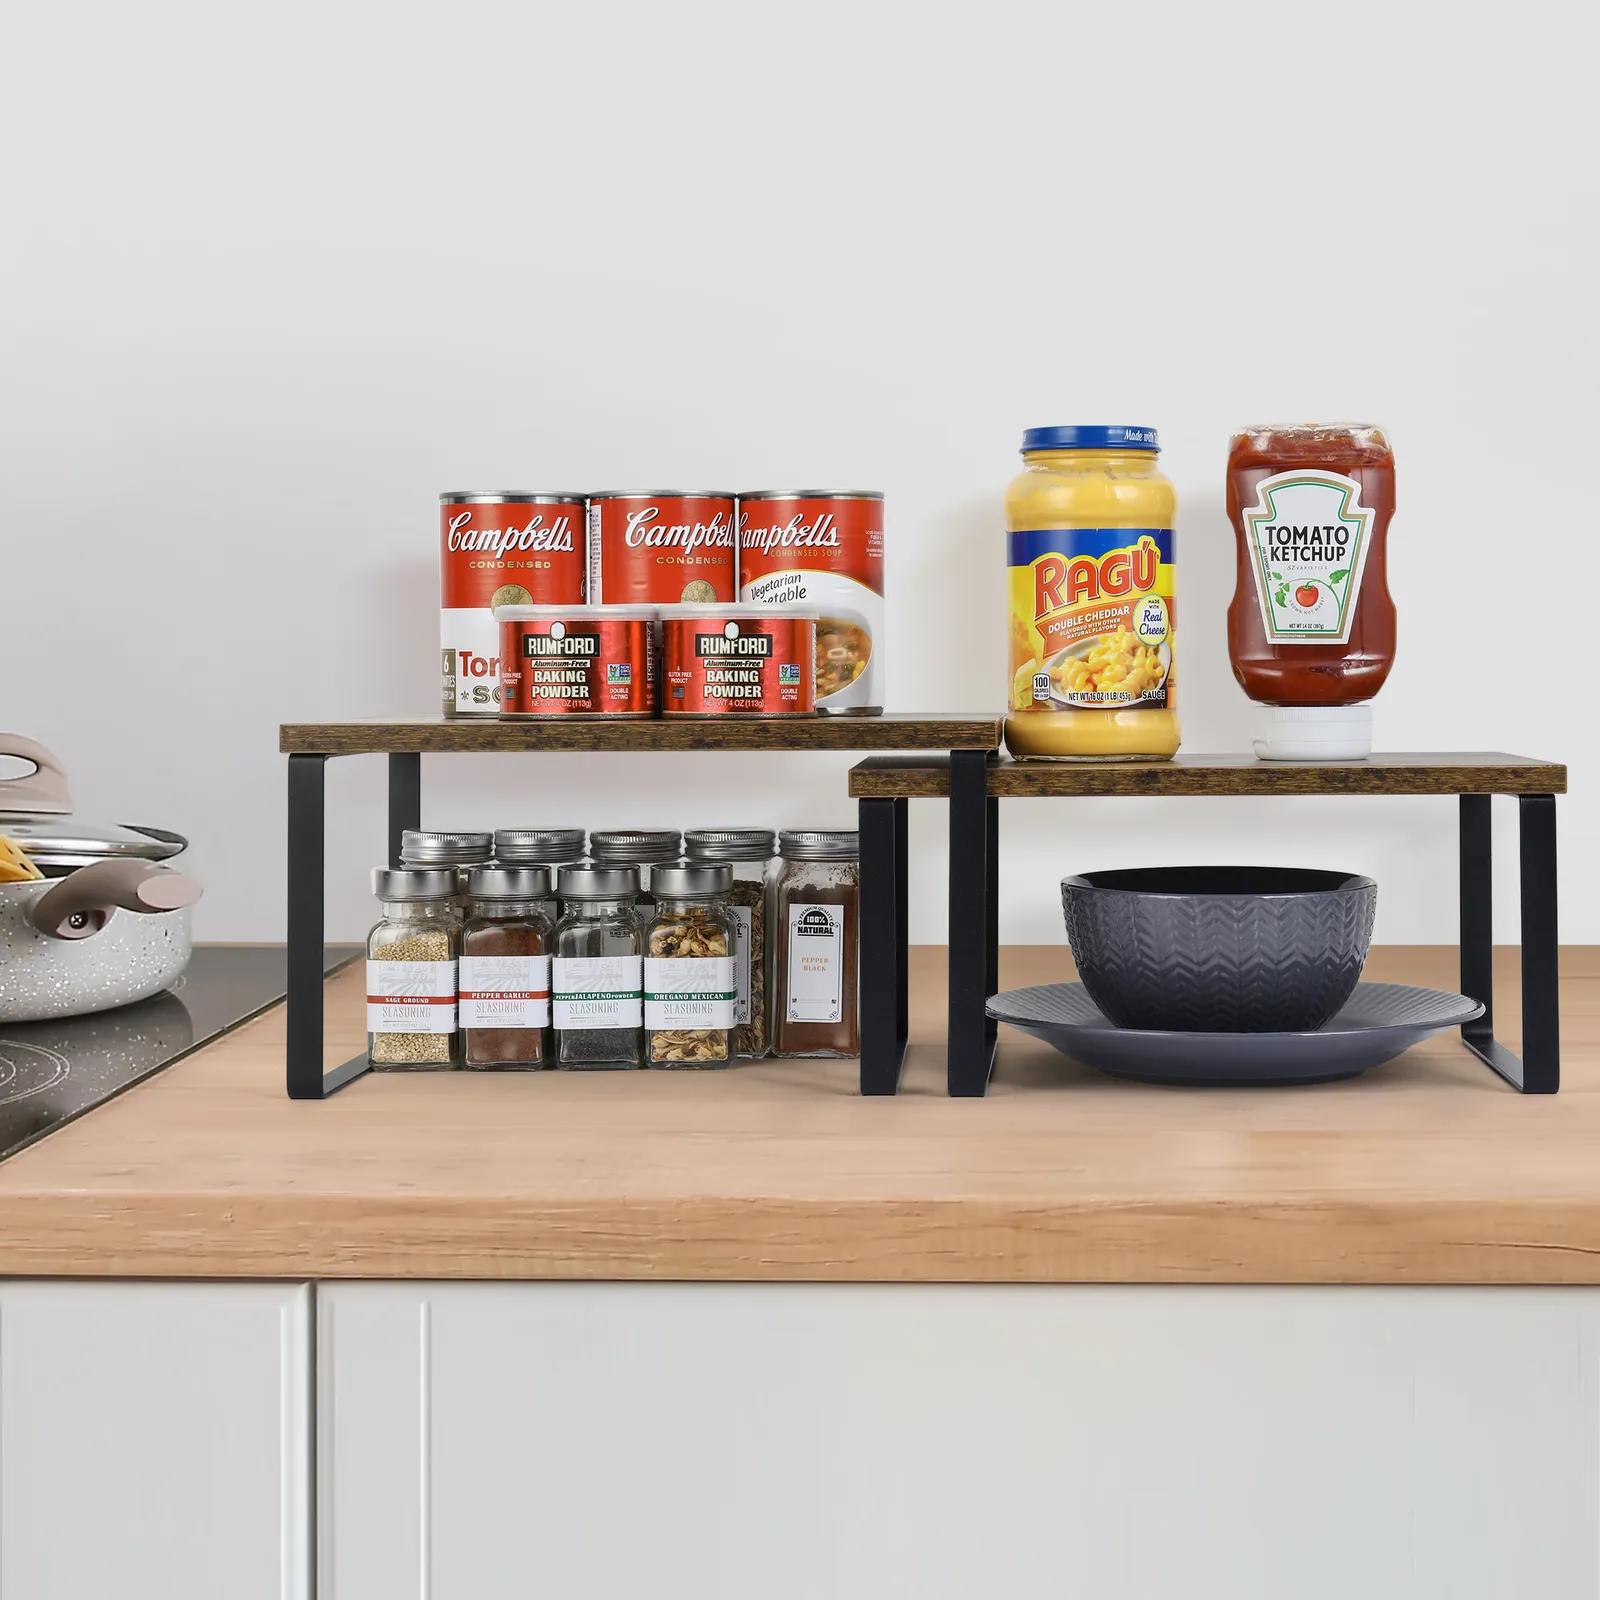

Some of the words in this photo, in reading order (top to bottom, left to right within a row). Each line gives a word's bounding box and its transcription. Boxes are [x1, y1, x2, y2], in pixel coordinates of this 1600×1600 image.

[1124, 429, 1143, 442] Made
[1265, 525, 1350, 546] TOMATO
[771, 549, 818, 557] CONDENSED
[822, 549, 842, 557] SOUP
[1270, 546, 1346, 562] KETCHUP
[469, 561, 551, 569] CONDENSED
[656, 556, 728, 565] CONDENSED
[751, 574, 802, 601] Vegetarian
[1048, 616, 1083, 634] DOUBLE
[1086, 605, 1131, 622] CHEDDAR
[1143, 609, 1163, 622] Real
[1060, 625, 1088, 637] FLAVORED
[1102, 618, 1121, 626] OTHER
[1066, 630, 1092, 640] NATURAL
[1092, 624, 1117, 634] FLAVORS
[1139, 623, 1166, 636] Cheese
[528, 637, 595, 655] RUMFORD
[700, 637, 768, 655] RUMFORD
[443, 654, 450, 673] 6
[534, 670, 586, 683] BAKING
[706, 670, 759, 683] BAKING
[1035, 676, 1048, 688] 100
[532, 685, 590, 698] POWDER
[704, 685, 762, 698] POWDER
[1068, 692, 1078, 700] NET
[1080, 692, 1089, 700] WT
[1090, 692, 1096, 700] 16
[1096, 692, 1104, 700] OZ
[1142, 690, 1166, 700] SAUCE
[572, 700, 592, 708] (113g)
[746, 700, 764, 708] (113g)
[798, 906, 818, 919] PREMIUM
[818, 906, 834, 921] QUALITY
[806, 916, 826, 924] 100%
[798, 926, 834, 934] NATURAL
[382, 1006, 431, 1018] SEASONING
[476, 1002, 525, 1013] SEASONING
[570, 1002, 618, 1014] SEASONING
[664, 1003, 713, 1014] SEASONING
